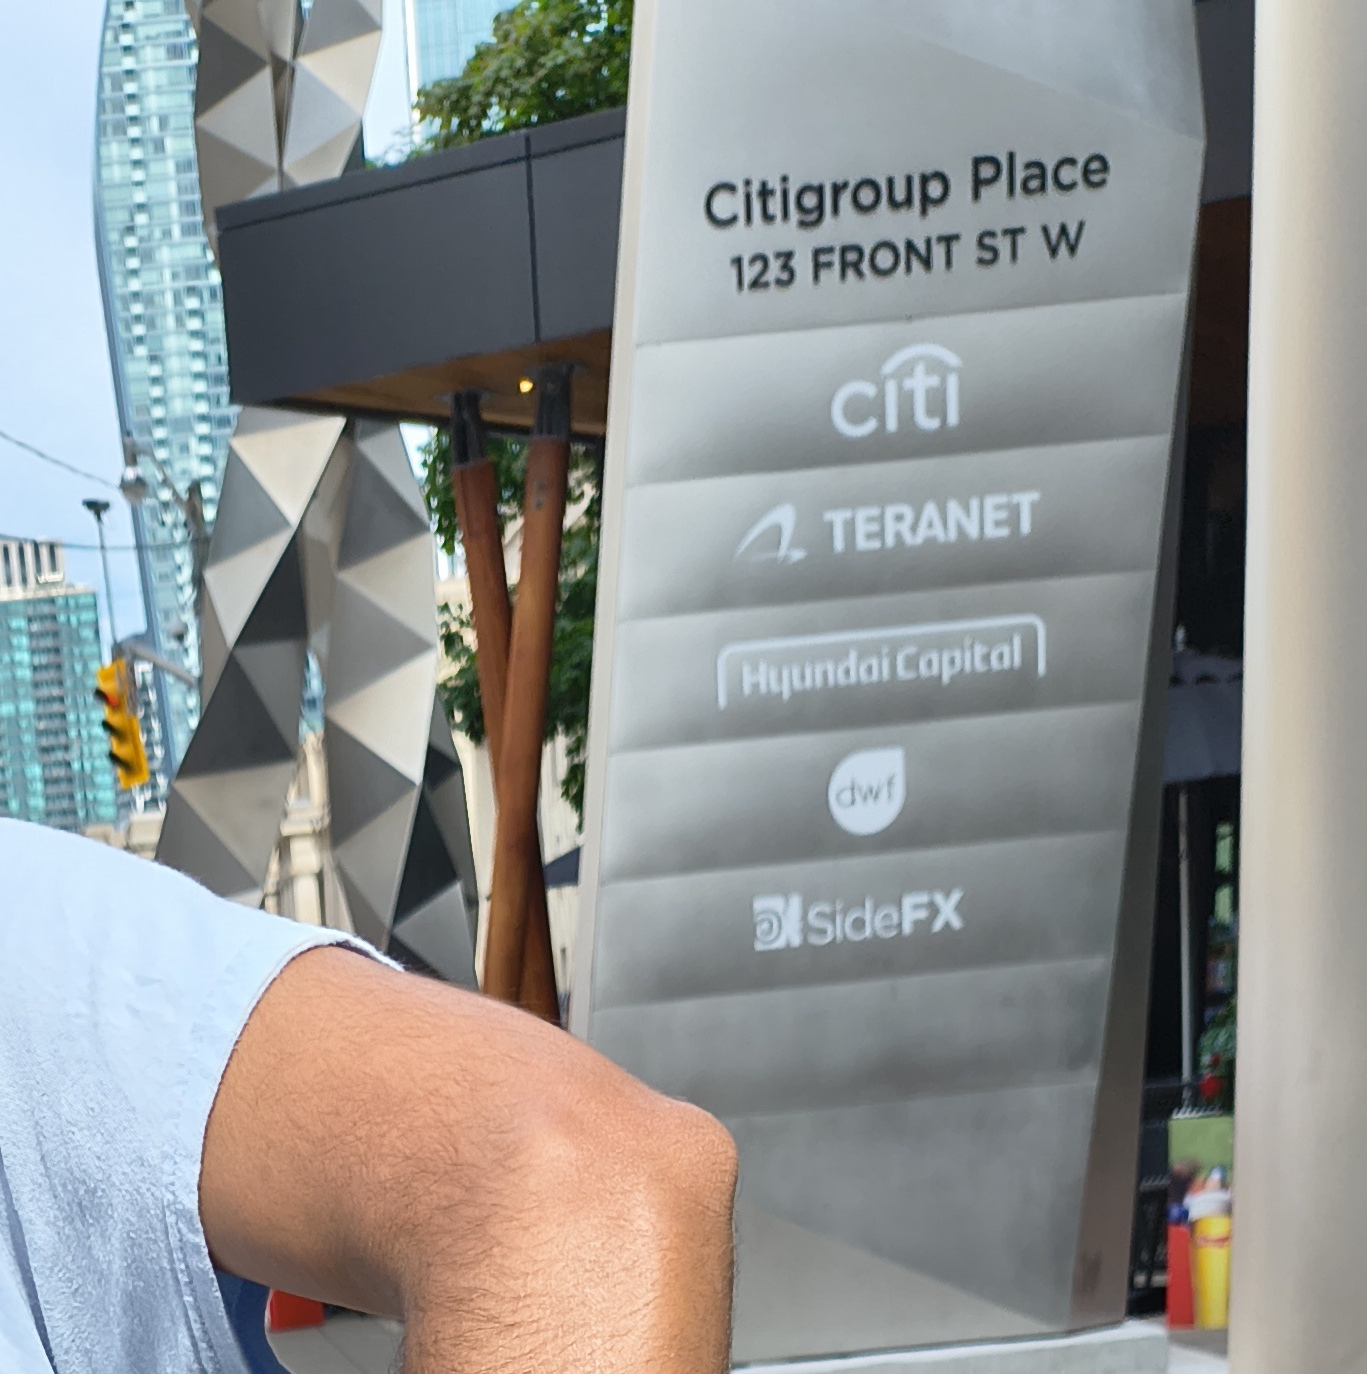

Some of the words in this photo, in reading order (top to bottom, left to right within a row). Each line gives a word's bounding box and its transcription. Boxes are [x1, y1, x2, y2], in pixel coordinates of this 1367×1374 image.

[704, 168, 951, 230] Citigroup
[970, 150, 1110, 203] Place
[731, 251, 797, 292] 123
[811, 232, 960, 286] FRONT
[975, 226, 1027, 267] ST
[1041, 219, 1086, 260] W
[830, 342, 963, 438] citi
[823, 493, 1040, 554] TERANET
[742, 647, 891, 701] Hyundai
[895, 633, 1023, 685] Capital
[836, 772, 897, 808] dwf
[806, 889, 964, 946] SideFX
